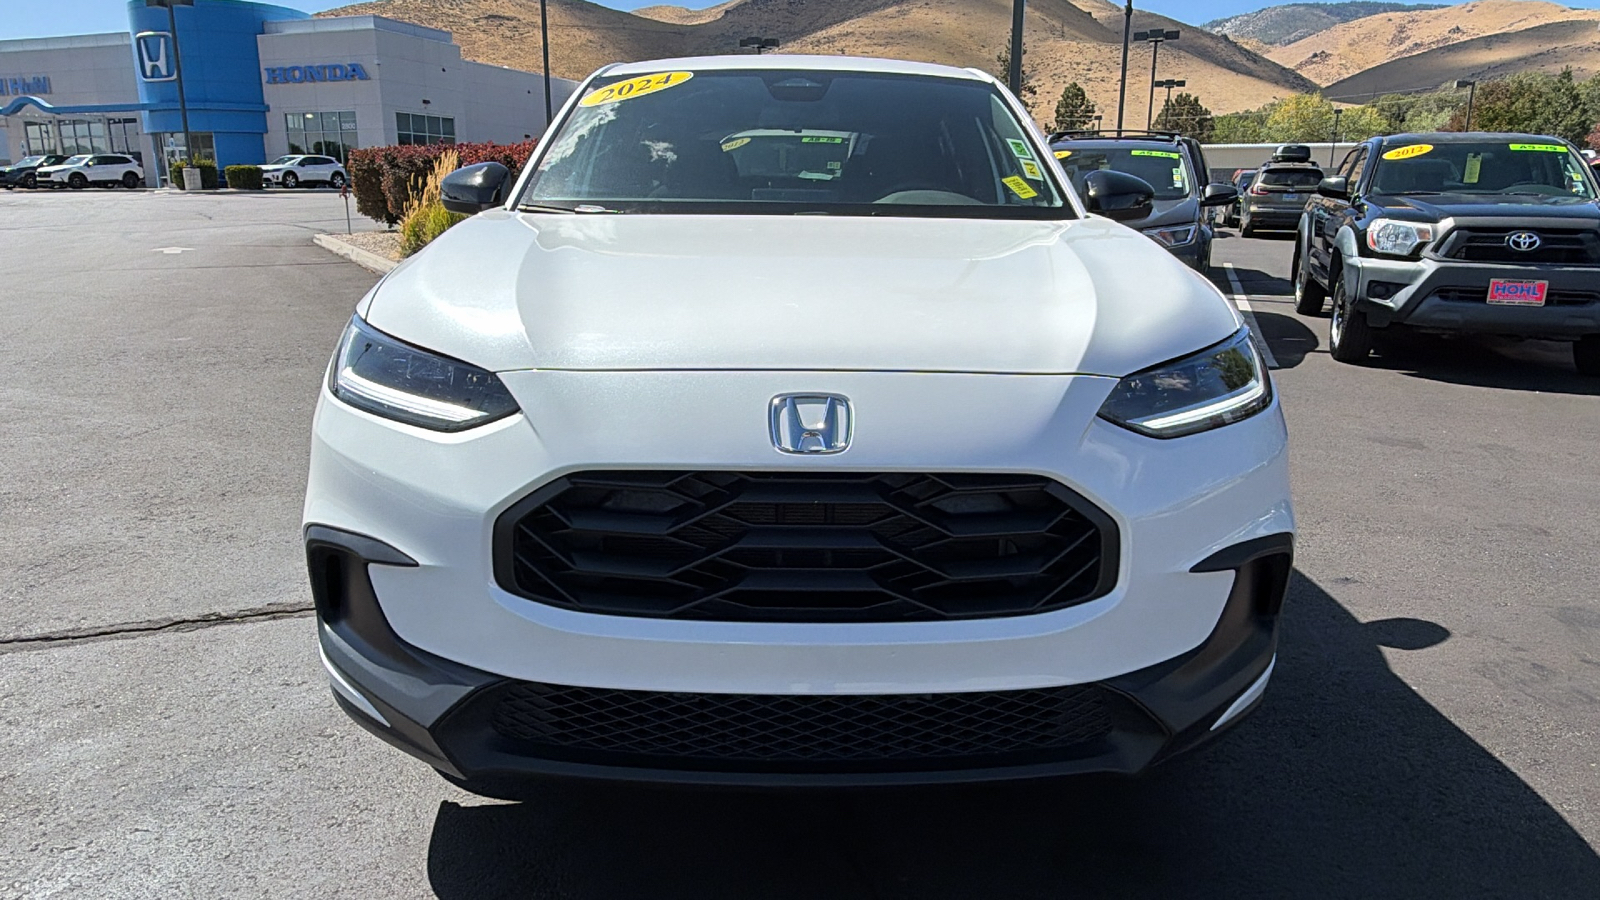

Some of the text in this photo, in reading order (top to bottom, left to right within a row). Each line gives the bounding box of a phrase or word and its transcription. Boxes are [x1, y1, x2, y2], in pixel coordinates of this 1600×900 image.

[264, 63, 371, 85] HONDA
[599, 73, 673, 103] 2024
[1394, 146, 1424, 157] 2012
[1494, 284, 1539, 296] HOHL
